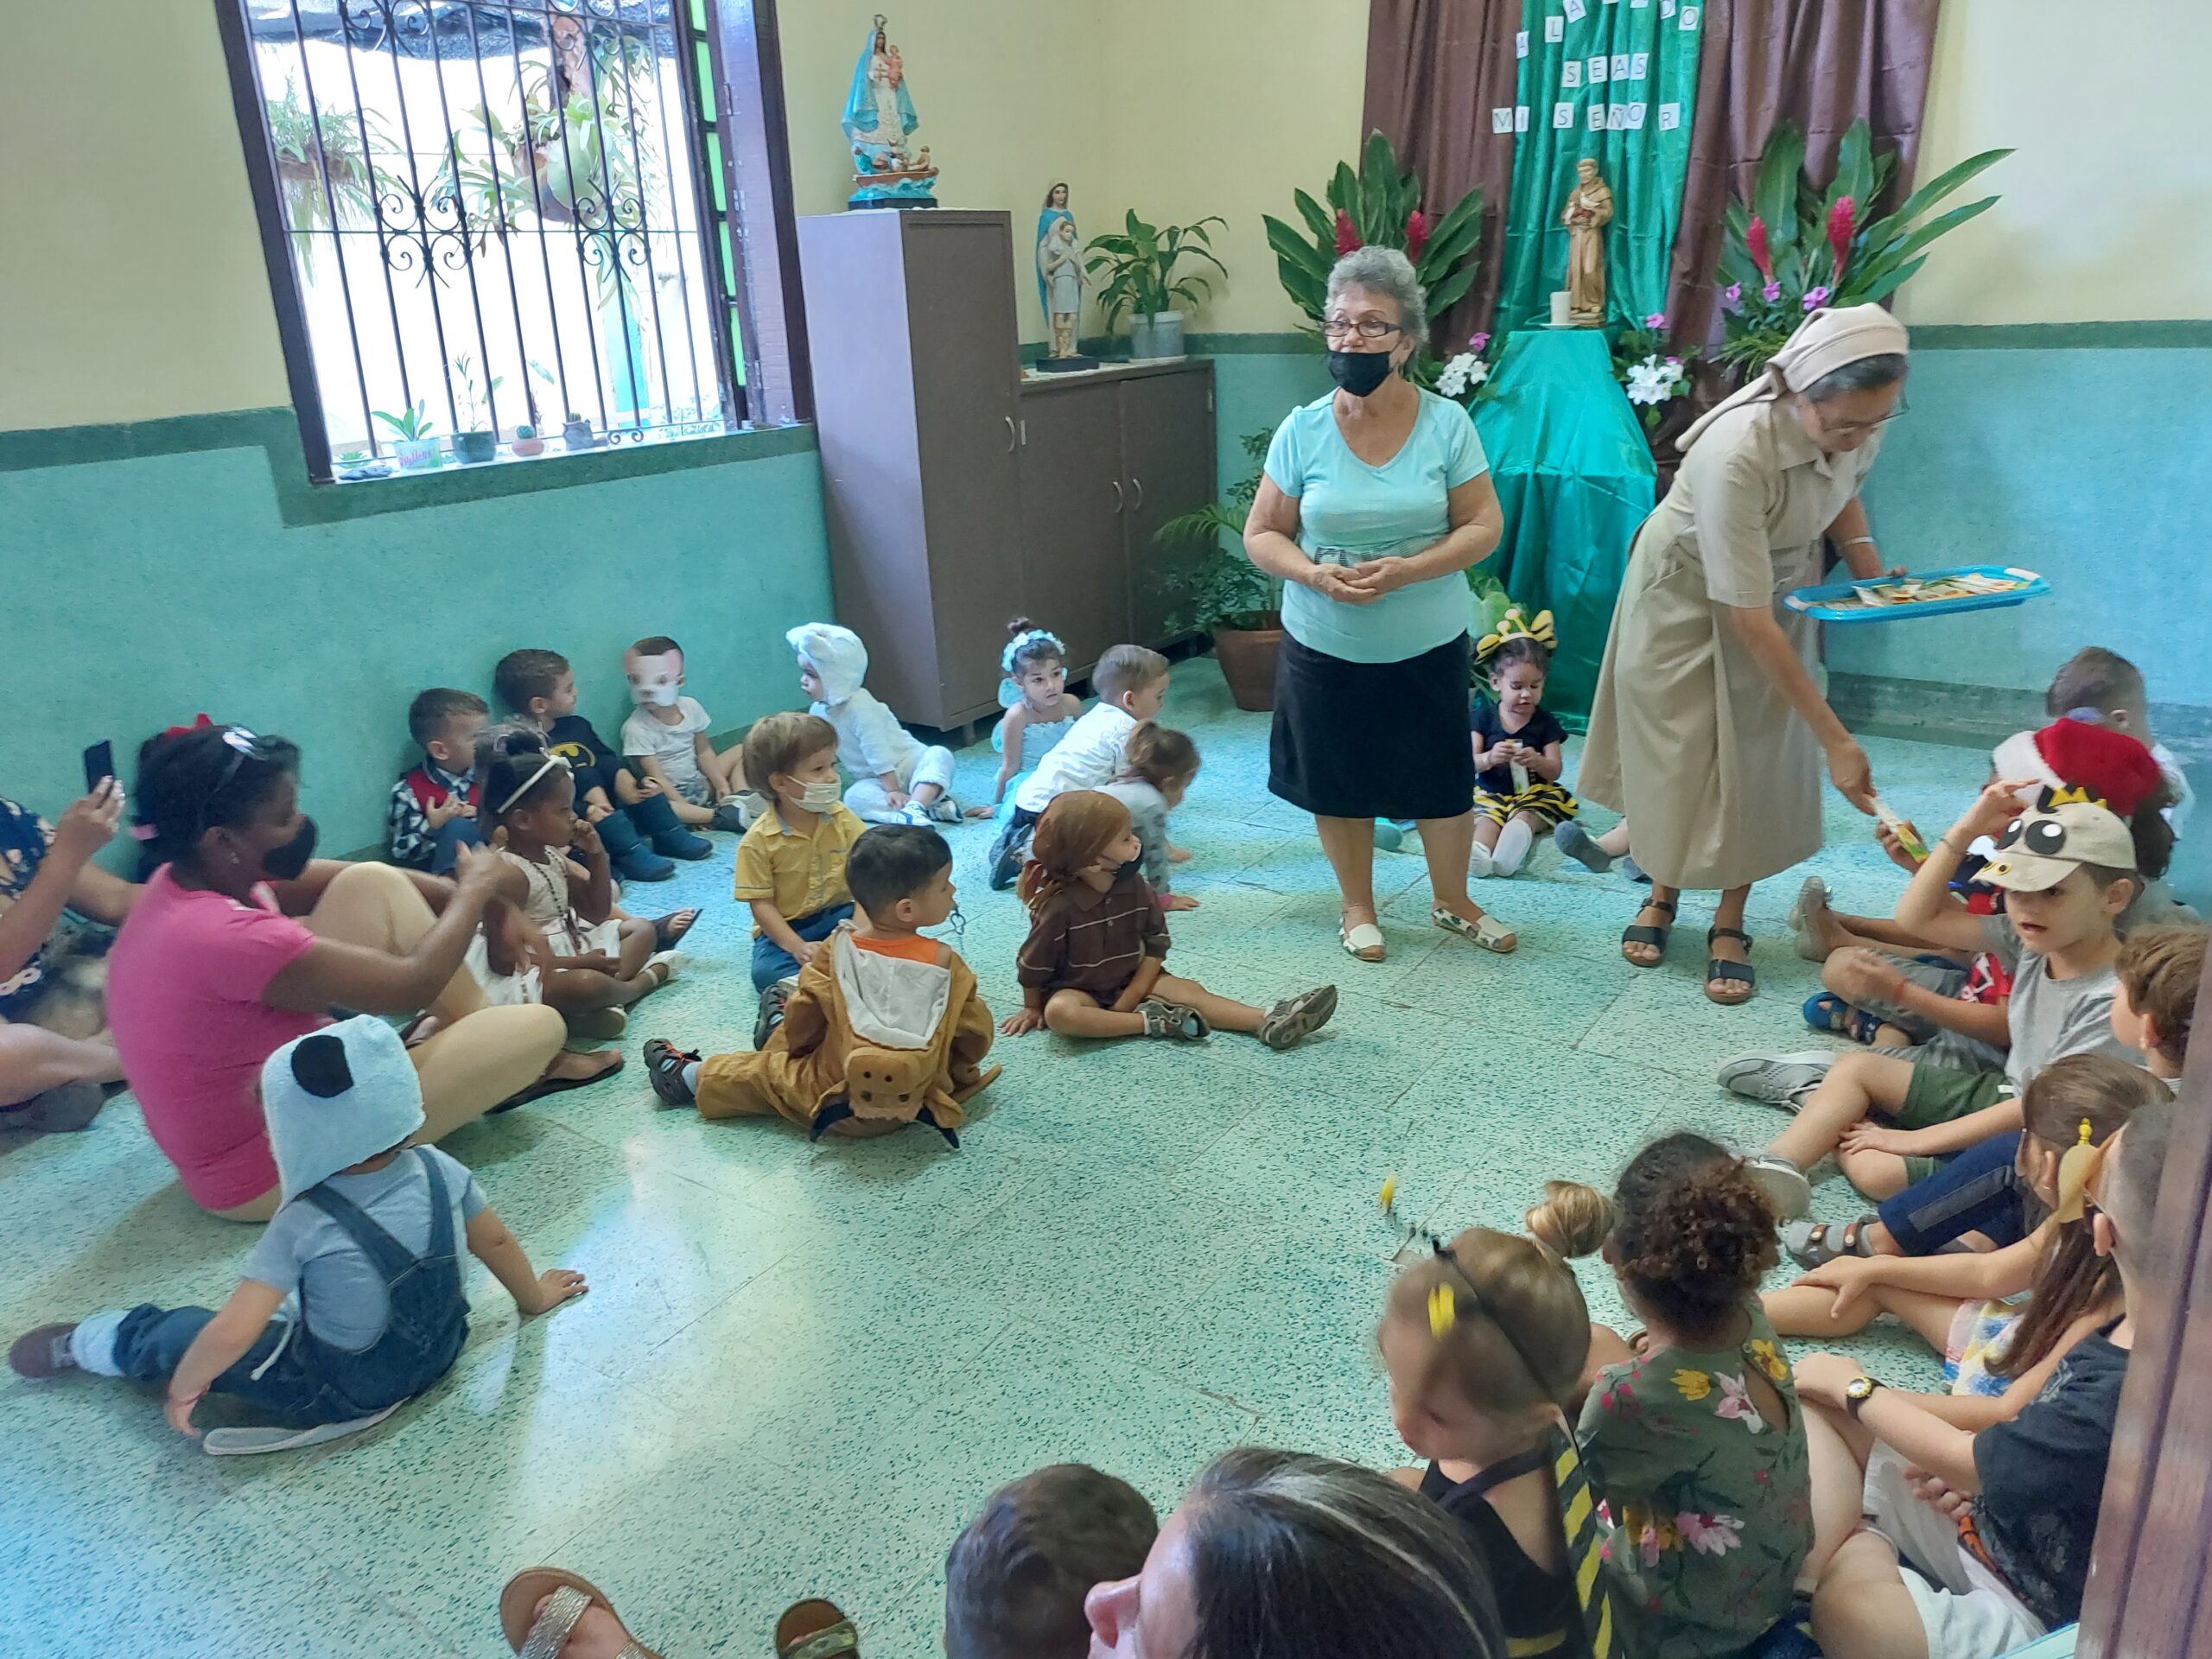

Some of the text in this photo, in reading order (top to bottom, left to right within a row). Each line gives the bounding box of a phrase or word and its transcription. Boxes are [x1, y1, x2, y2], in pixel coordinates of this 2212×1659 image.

[1518, 0, 1698, 51] ALADO
[1567, 56, 1646, 83] SEAS
[1493, 104, 1675, 130] MI SEÑOR
